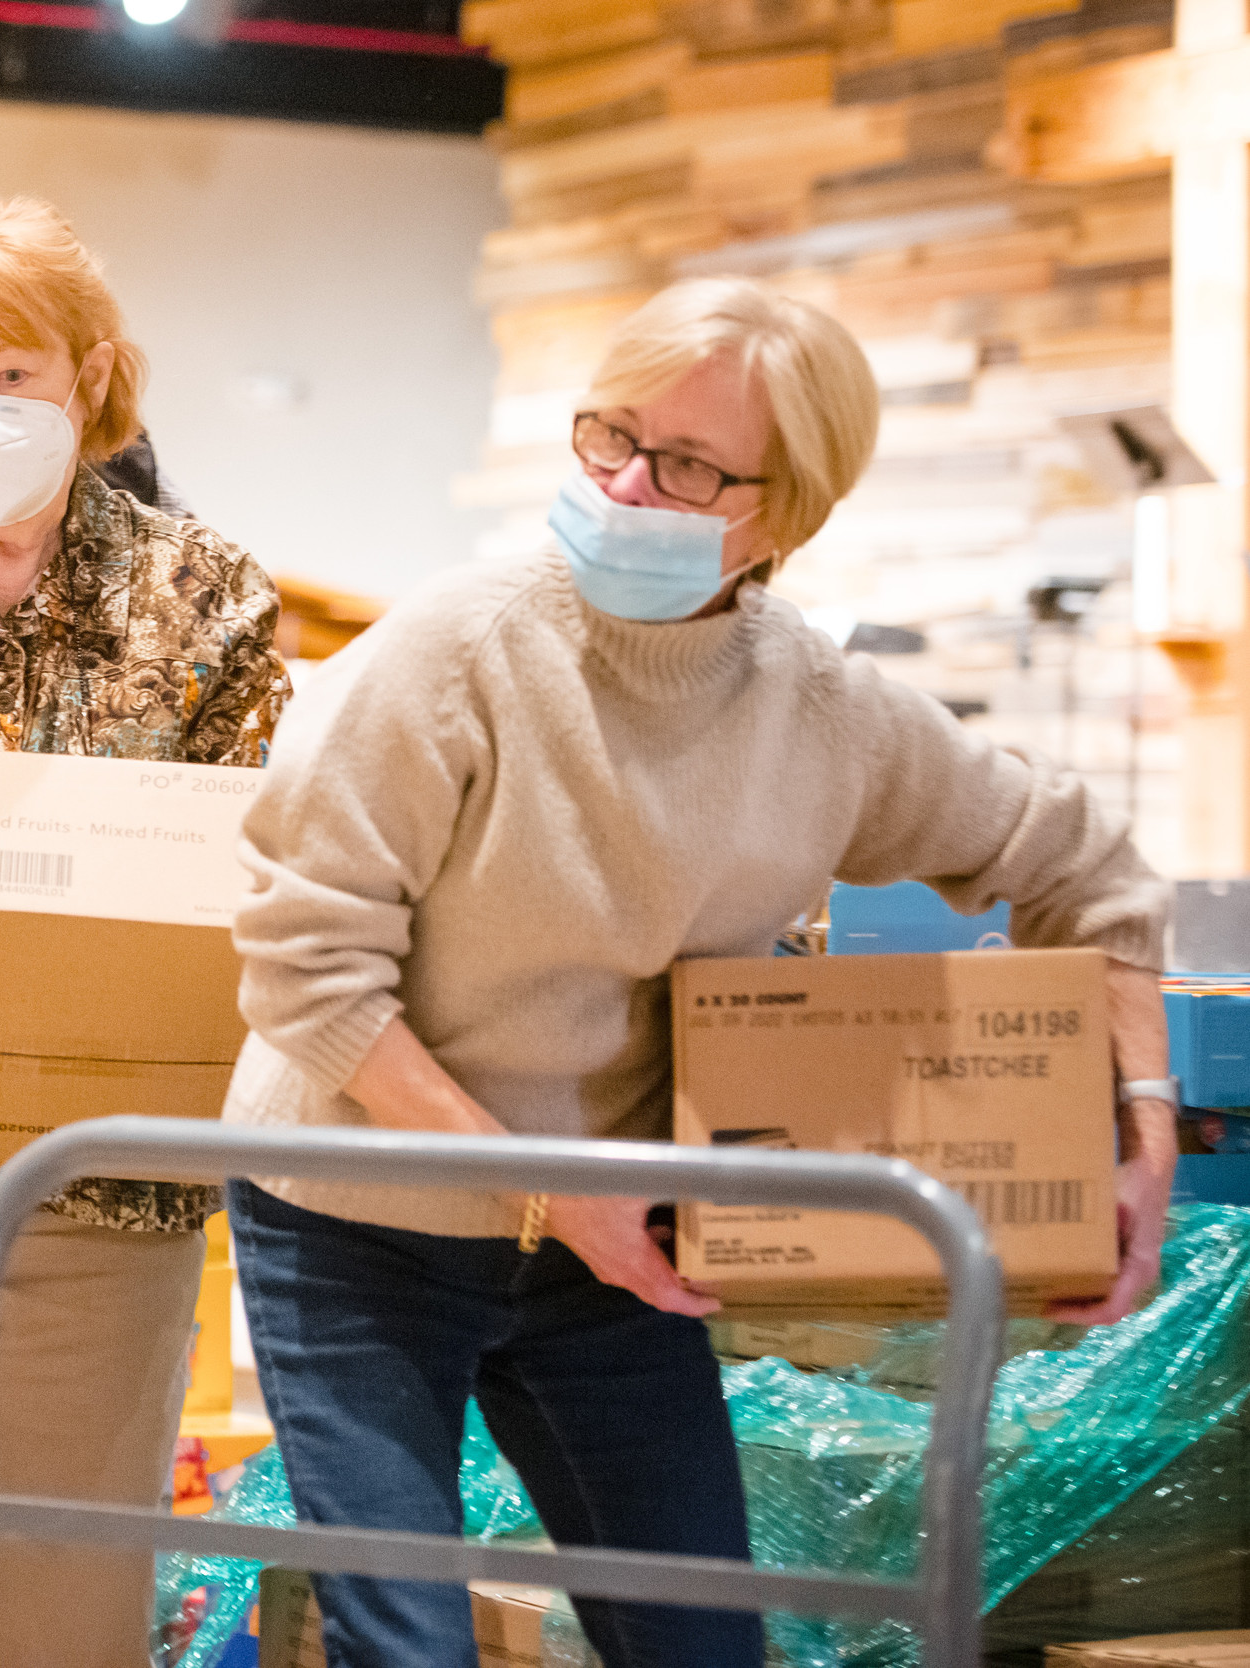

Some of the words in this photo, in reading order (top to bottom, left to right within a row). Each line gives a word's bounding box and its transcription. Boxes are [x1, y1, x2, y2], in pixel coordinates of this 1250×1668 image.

[18, 816, 71, 834] Fruits
[90, 822, 147, 840] Mixed
[153, 826, 207, 844] Fruits
[977, 1009, 1081, 1038] 104198
[903, 1055, 1050, 1080] TOASTCHEE
